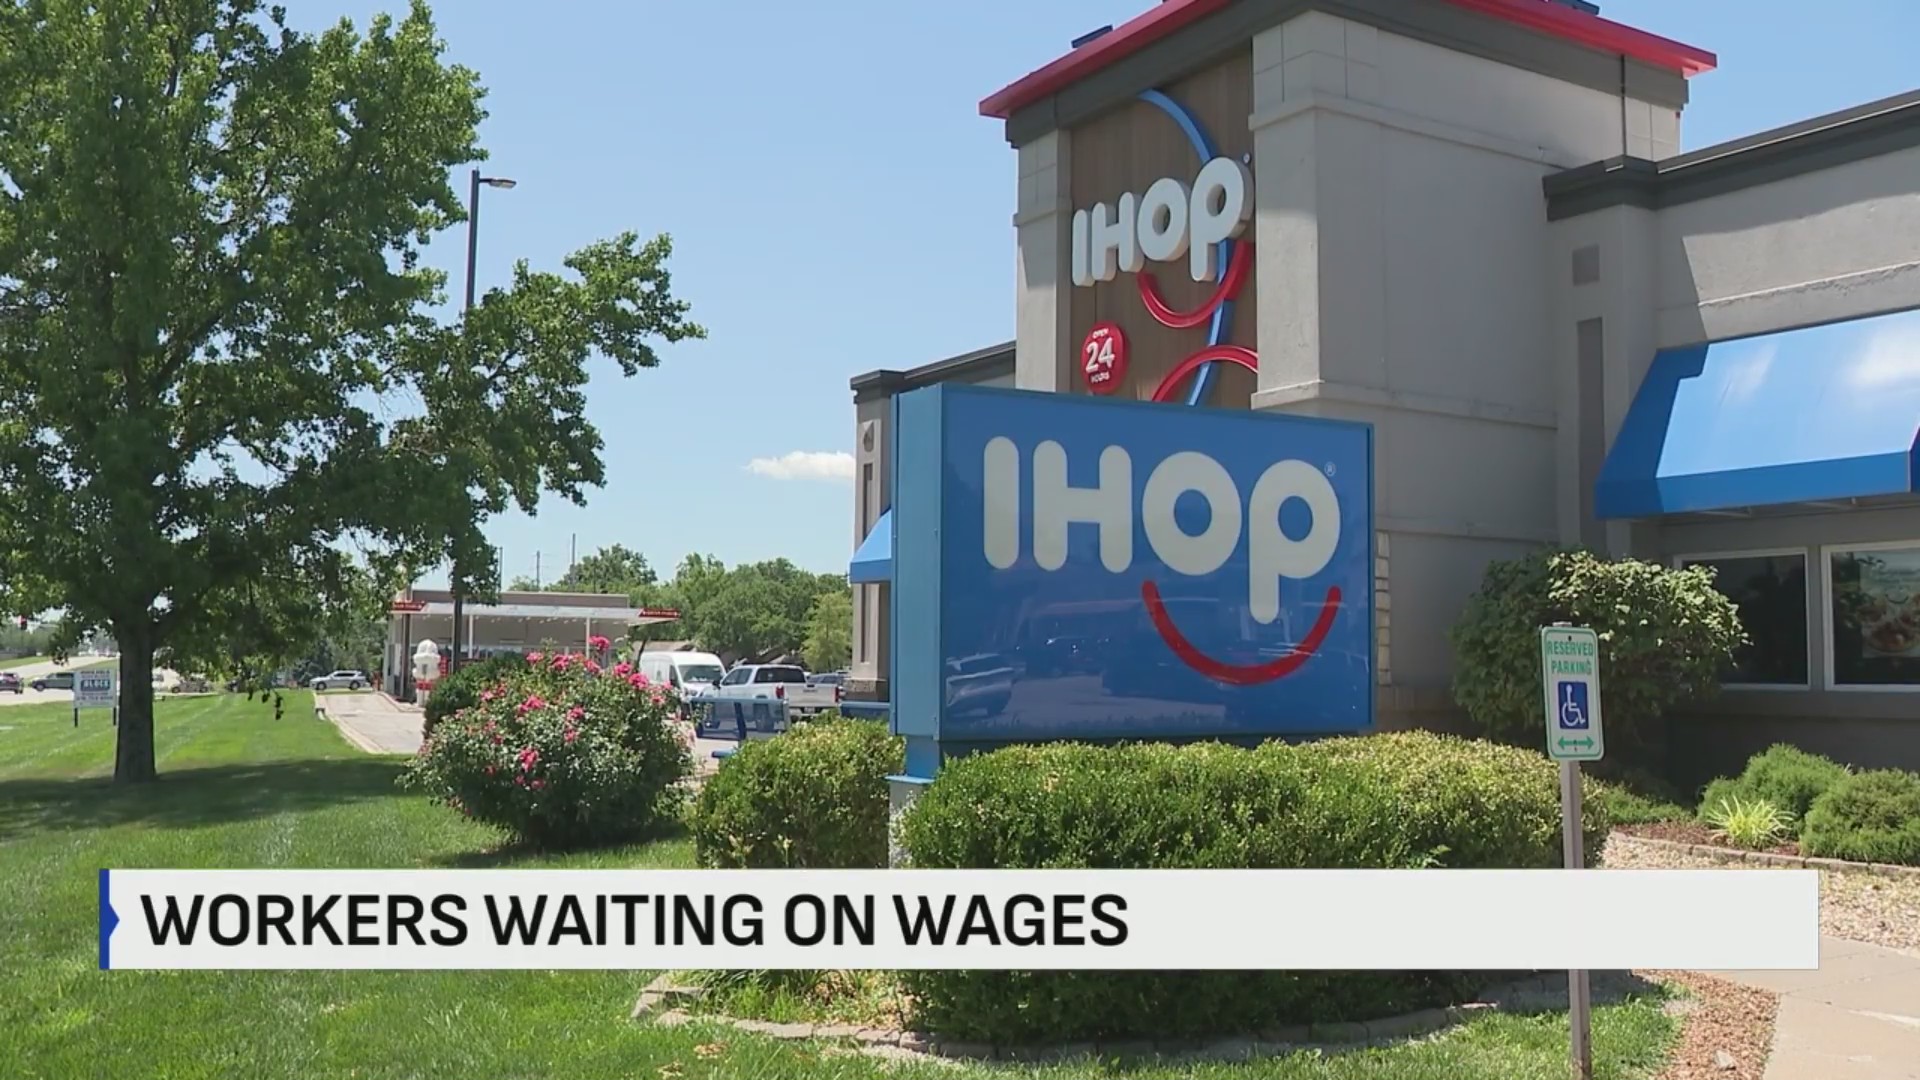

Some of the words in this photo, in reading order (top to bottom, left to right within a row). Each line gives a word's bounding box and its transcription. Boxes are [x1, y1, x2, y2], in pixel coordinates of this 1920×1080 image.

[1085, 337, 1115, 373] 24
[1547, 641, 1594, 656] RESERVED
[1551, 659, 1592, 675] PARKING
